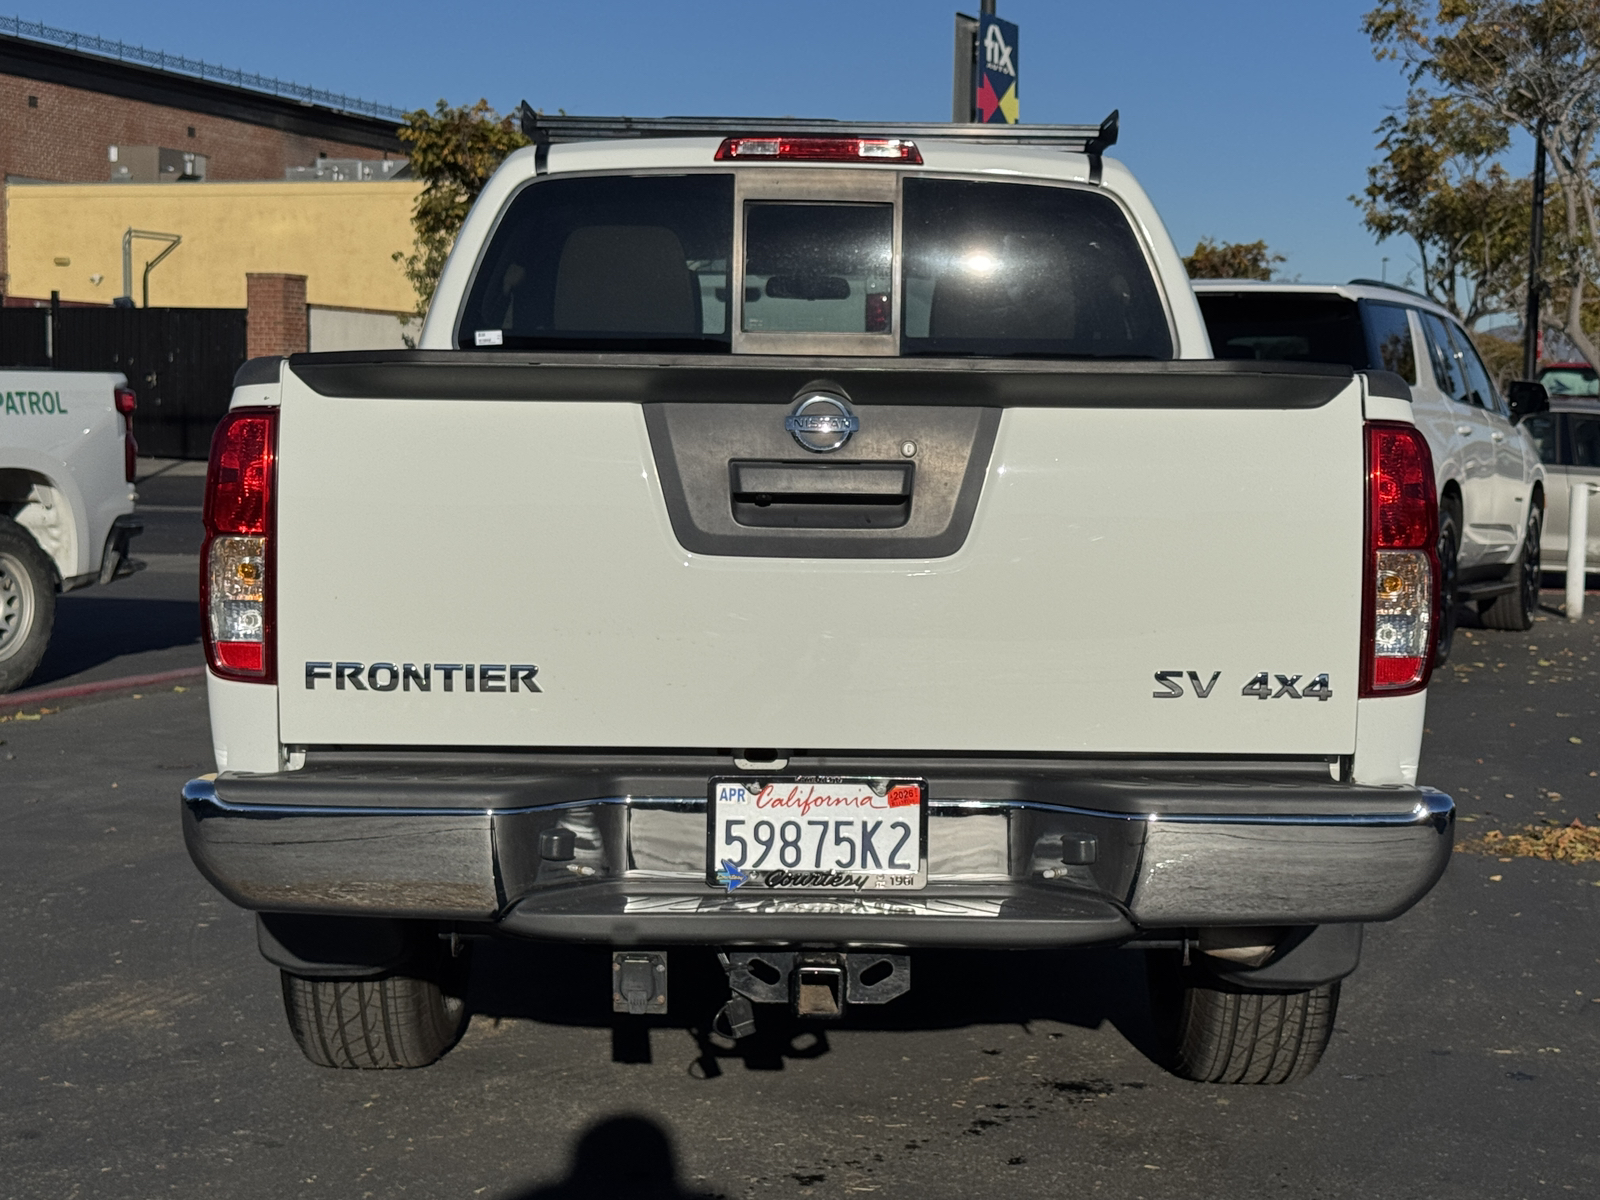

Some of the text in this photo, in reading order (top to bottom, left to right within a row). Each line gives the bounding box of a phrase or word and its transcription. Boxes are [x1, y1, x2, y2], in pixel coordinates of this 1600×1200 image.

[984, 24, 1016, 77] fix
[305, 661, 543, 693] FRONTIER
[1153, 671, 1222, 698] SV
[719, 787, 746, 802] APR
[756, 784, 888, 817] California
[893, 790, 914, 800] 2026
[725, 819, 911, 869] 59875K2
[764, 869, 868, 892] Courtesy
